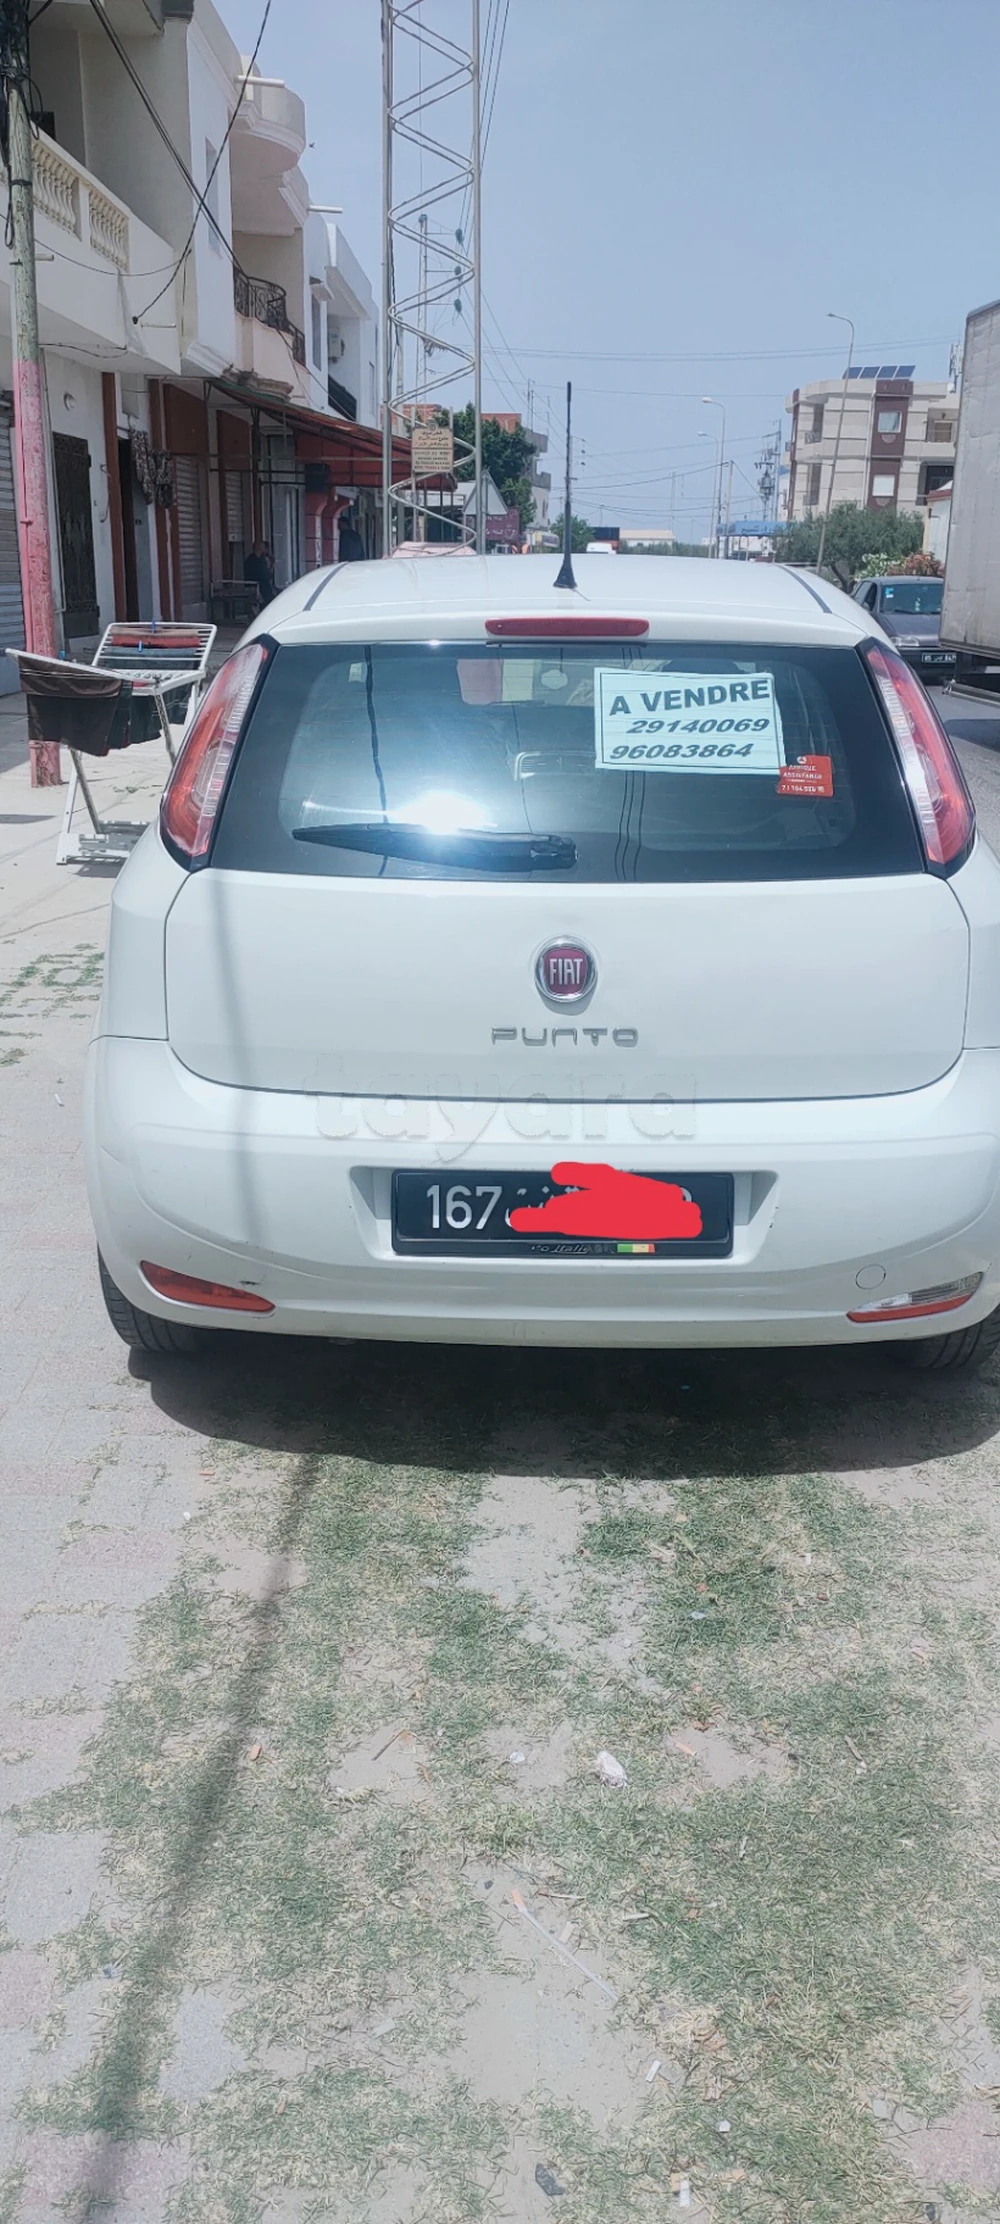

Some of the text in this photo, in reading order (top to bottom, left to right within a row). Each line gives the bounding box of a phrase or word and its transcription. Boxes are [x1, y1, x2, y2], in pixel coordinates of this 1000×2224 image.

[609, 680, 770, 716] A VENDRE
[626, 718, 769, 734] 29140069
[609, 743, 754, 760] 96083864
[549, 958, 583, 985] FIAT
[491, 1027, 638, 1047] PUNTO
[426, 1184, 503, 1230] 167
